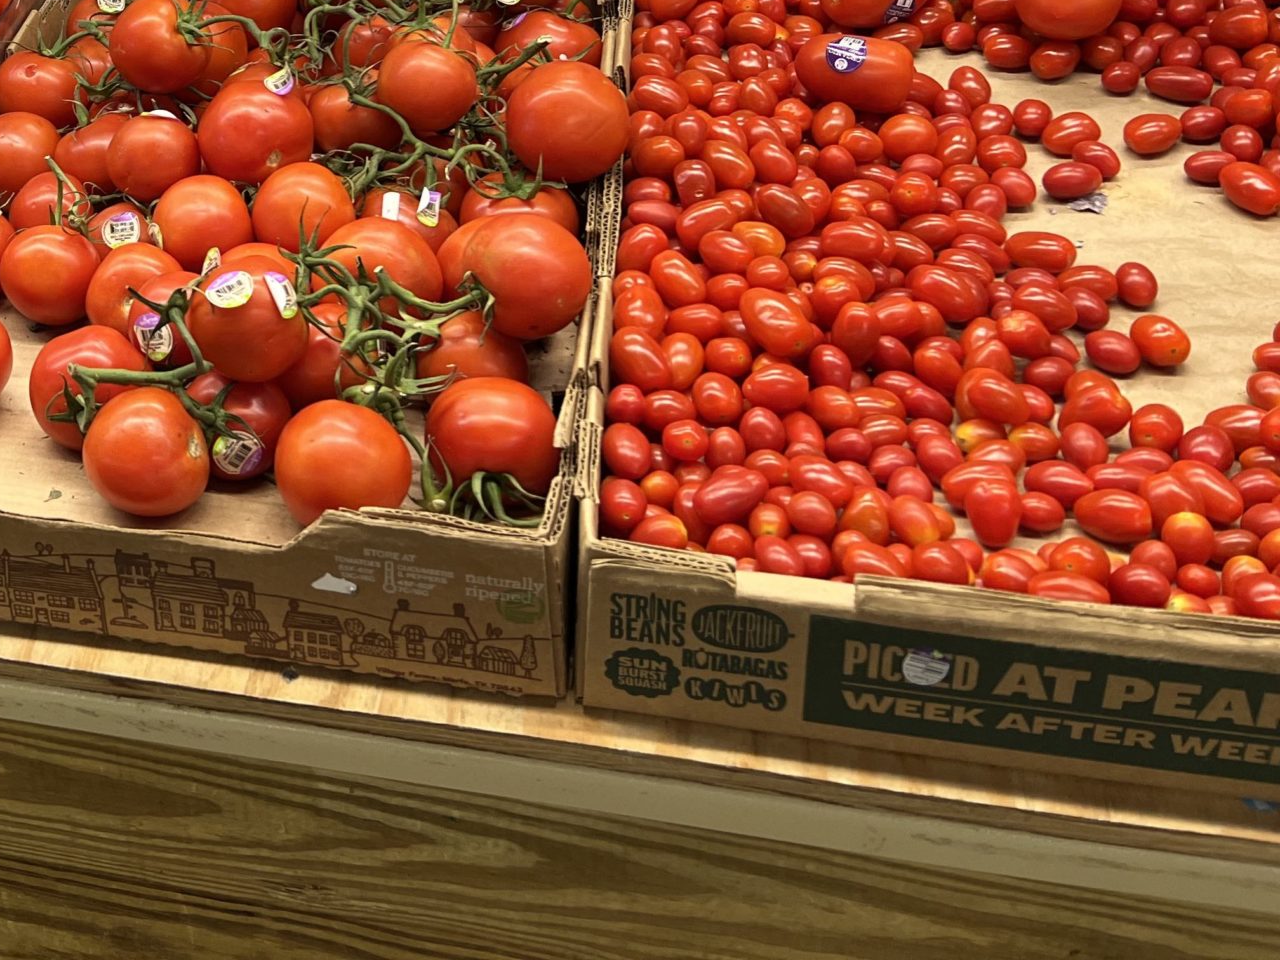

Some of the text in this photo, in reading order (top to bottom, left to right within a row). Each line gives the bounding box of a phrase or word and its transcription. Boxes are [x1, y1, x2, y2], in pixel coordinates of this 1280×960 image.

[465, 572, 545, 594] naturally
[465, 585, 533, 605] ripened
[610, 592, 686, 625] STRING
[609, 618, 686, 647] BEANS
[695, 610, 783, 649] JACKFRUIT
[618, 656, 668, 671] SUN
[618, 667, 668, 682] BURST
[617, 677, 668, 690] SQUASH
[991, 662, 1092, 705] AT
[840, 690, 985, 728] WEEK
[995, 712, 1157, 751] AFTER
